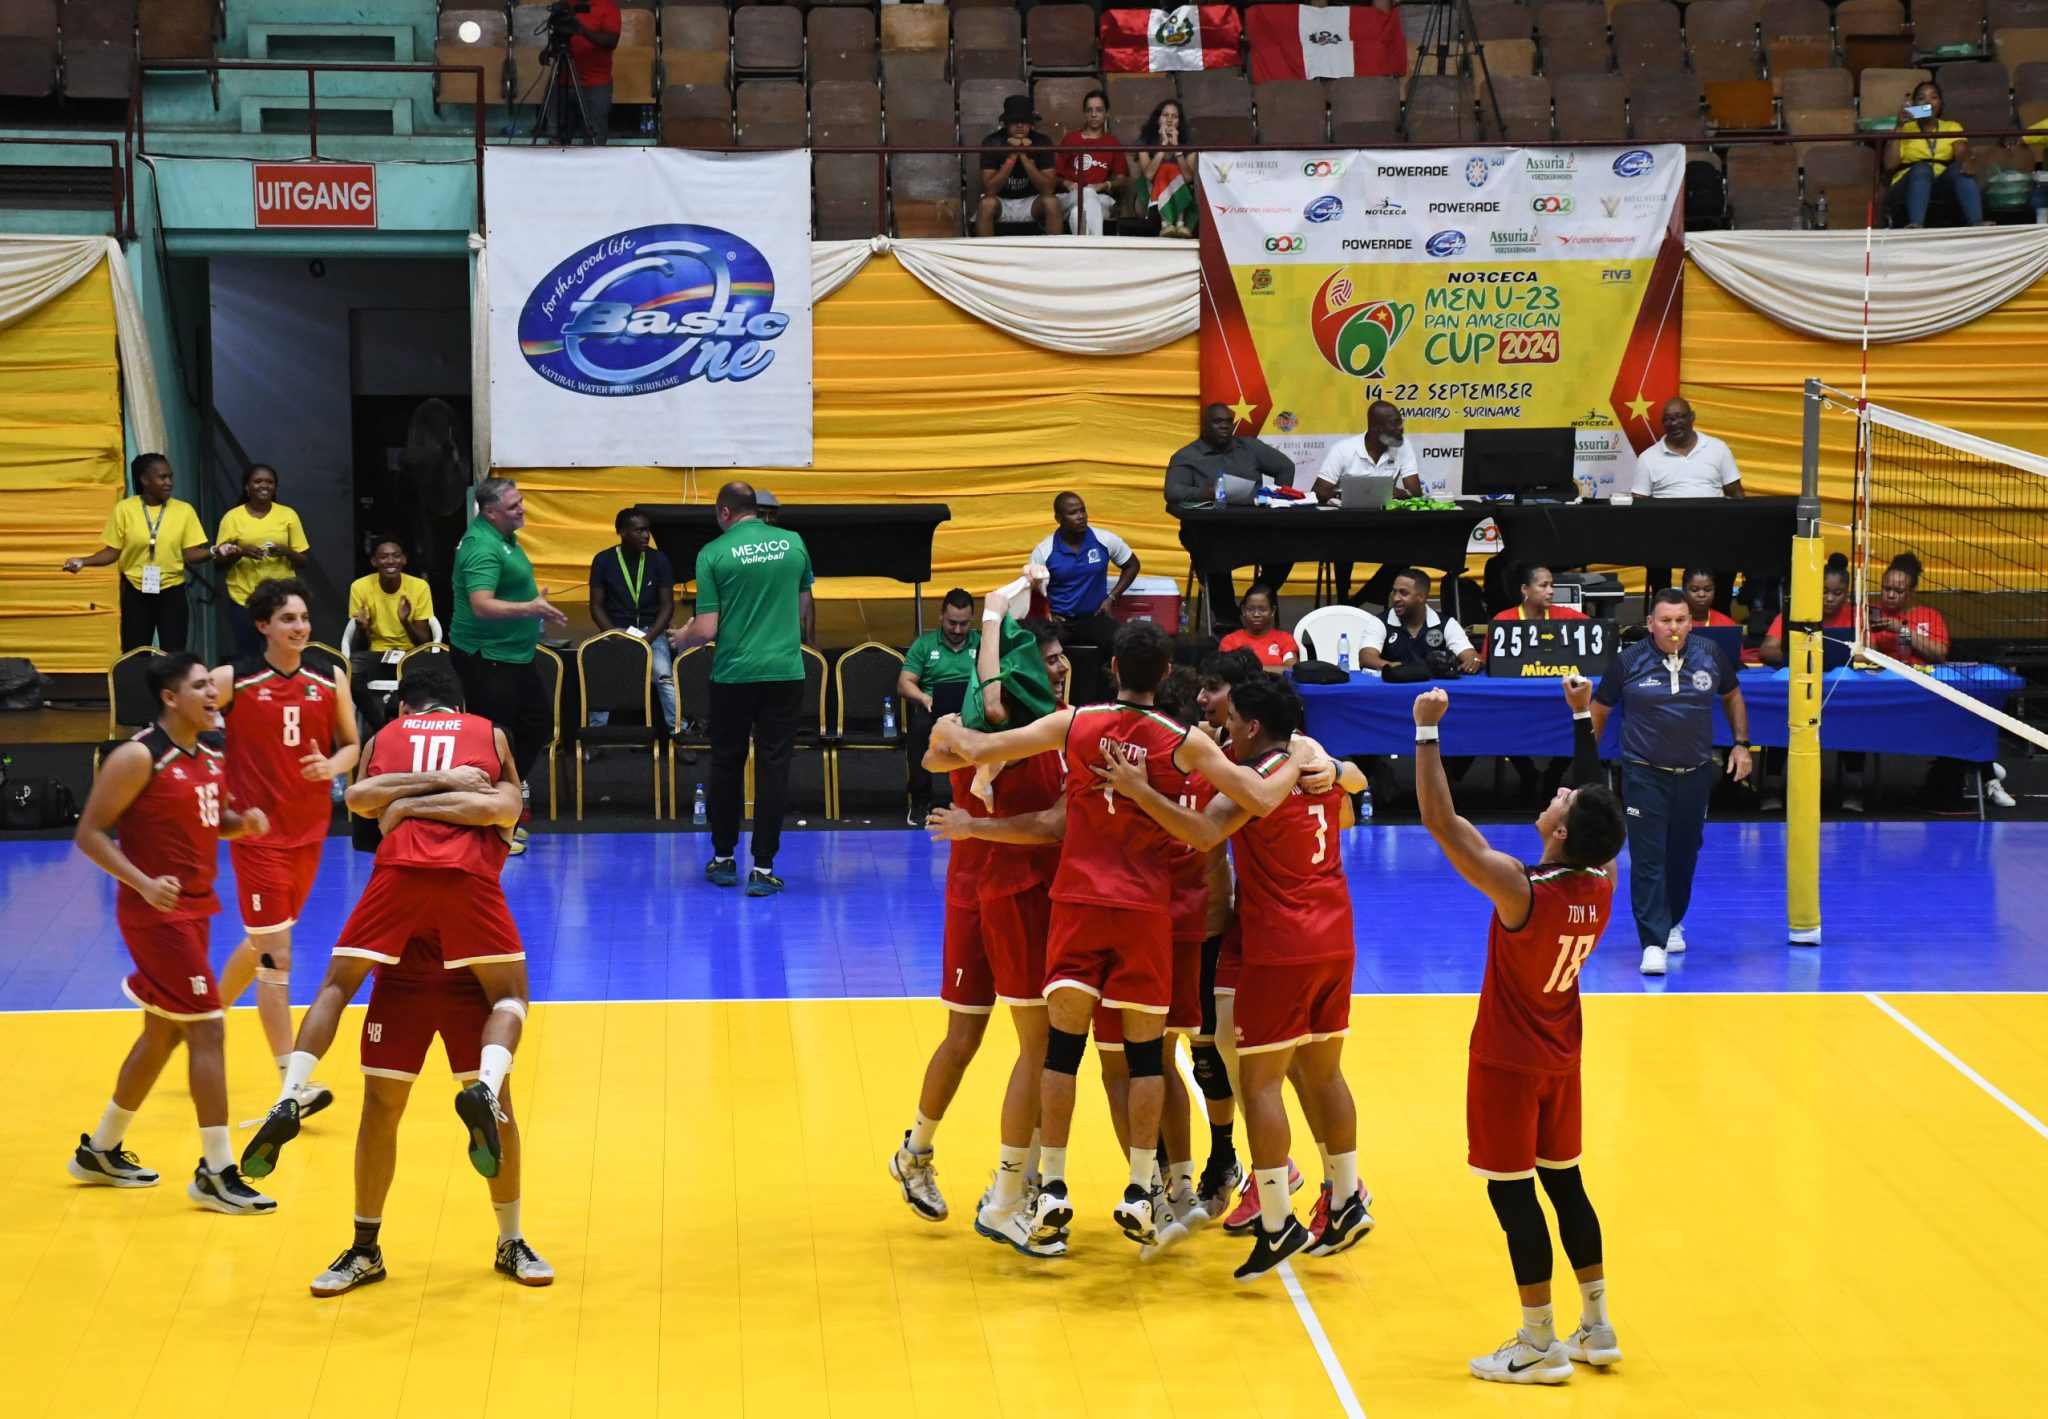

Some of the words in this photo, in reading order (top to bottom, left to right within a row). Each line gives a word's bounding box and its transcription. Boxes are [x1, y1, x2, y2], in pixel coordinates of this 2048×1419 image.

[1525, 153, 1565, 170] Assuria
[1377, 166, 1449, 177] POWERADE
[258, 181, 372, 211] UITGANG
[1532, 196, 1572, 213] GO2
[1429, 202, 1500, 213] POWERADE
[1265, 235, 1304, 252] GO2
[1342, 238, 1413, 250] POWERADE
[1489, 227, 1528, 243] Assuria
[541, 294, 558, 322] for
[555, 273, 577, 299] the
[576, 243, 607, 284] good
[608, 235, 637, 256] life
[1447, 271, 1539, 284] NORCECA
[1424, 286, 1487, 312] MEN
[1495, 285, 1562, 311] U-23
[561, 301, 790, 341] Basic
[1424, 314, 1461, 330] PAN
[1465, 312, 1561, 330] AMERICAN
[1424, 332, 1496, 366] CUP
[1501, 331, 1557, 361] 2024
[538, 363, 576, 389] NATURAL
[578, 381, 608, 395] WATER
[609, 384, 634, 395] FROM
[635, 375, 680, 393] SURINAME
[1365, 383, 1420, 401] 14-22
[1428, 382, 1534, 401] SEPTEMBER
[1399, 406, 1451, 419] AMARIBO
[1463, 405, 1521, 418] SURINAME
[731, 539, 790, 558] MEXICO
[741, 551, 785, 565] Volleyball
[1493, 626, 1523, 657] 25
[1528, 625, 1539, 647] 2
[1561, 624, 1569, 646] 1
[1573, 624, 1603, 655] 13
[282, 705, 301, 748] 8
[402, 718, 463, 731] AGUIRRE
[409, 734, 456, 774] 10
[1308, 803, 1328, 865] 3
[251, 893, 262, 912] 8
[1589, 904, 1599, 924] H.
[1542, 934, 1596, 994] 18
[955, 967, 963, 987] 7
[367, 1021, 383, 1043] 48
